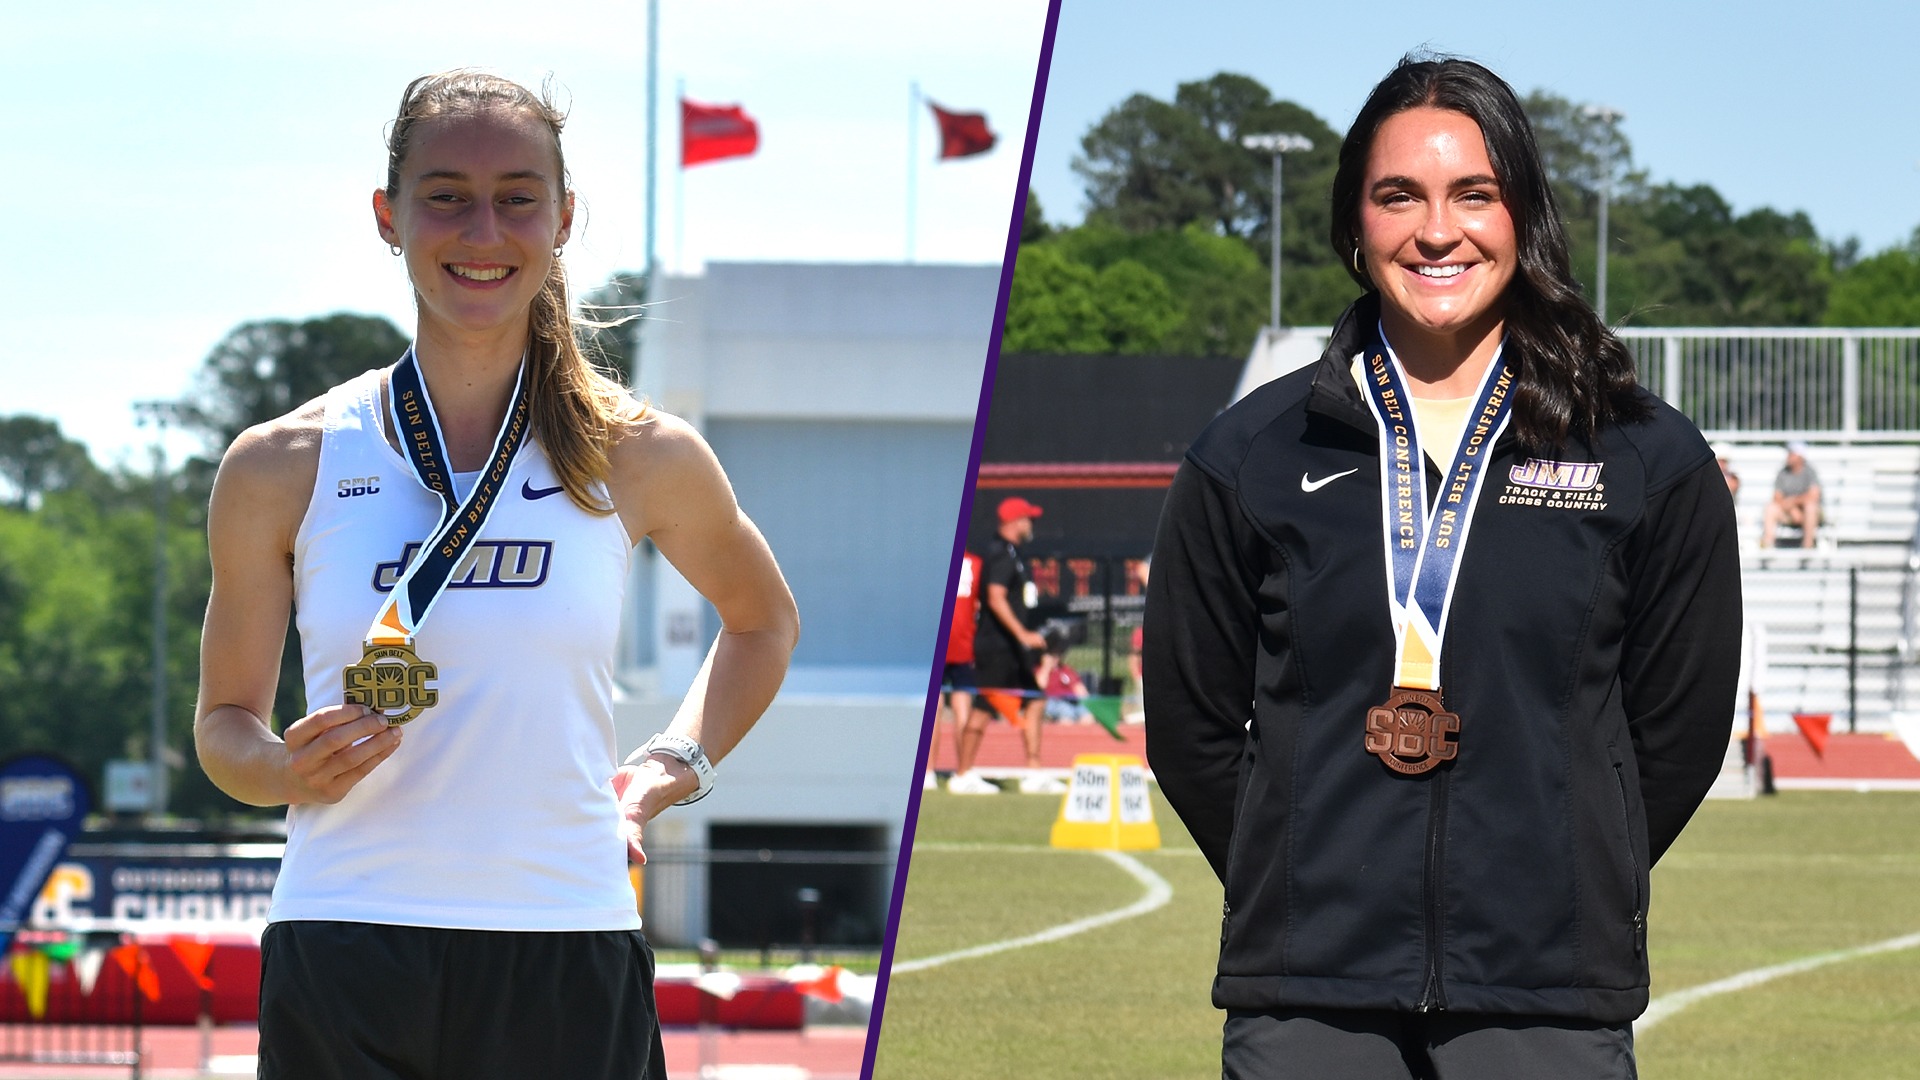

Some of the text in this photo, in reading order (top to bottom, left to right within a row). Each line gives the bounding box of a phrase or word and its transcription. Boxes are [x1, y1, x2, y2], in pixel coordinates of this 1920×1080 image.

[402, 390, 423, 426] SUN
[413, 430, 437, 469] BELT
[1371, 353, 1415, 549] SUN BELT CONFERENCE
[337, 476, 380, 498] SBC
[1505, 486, 1603, 501] TRACK & FIELD
[1509, 457, 1604, 491] JMU
[442, 523, 468, 558] SUN
[468, 483, 492, 524] BELT
[1436, 509, 1457, 548] SUN
[1447, 462, 1472, 504] BELT
[1499, 495, 1608, 511] CROSS COUNTRY
[373, 649, 405, 659] SUN BELT
[343, 663, 438, 709] SBC
[1365, 706, 1460, 760] SBC
